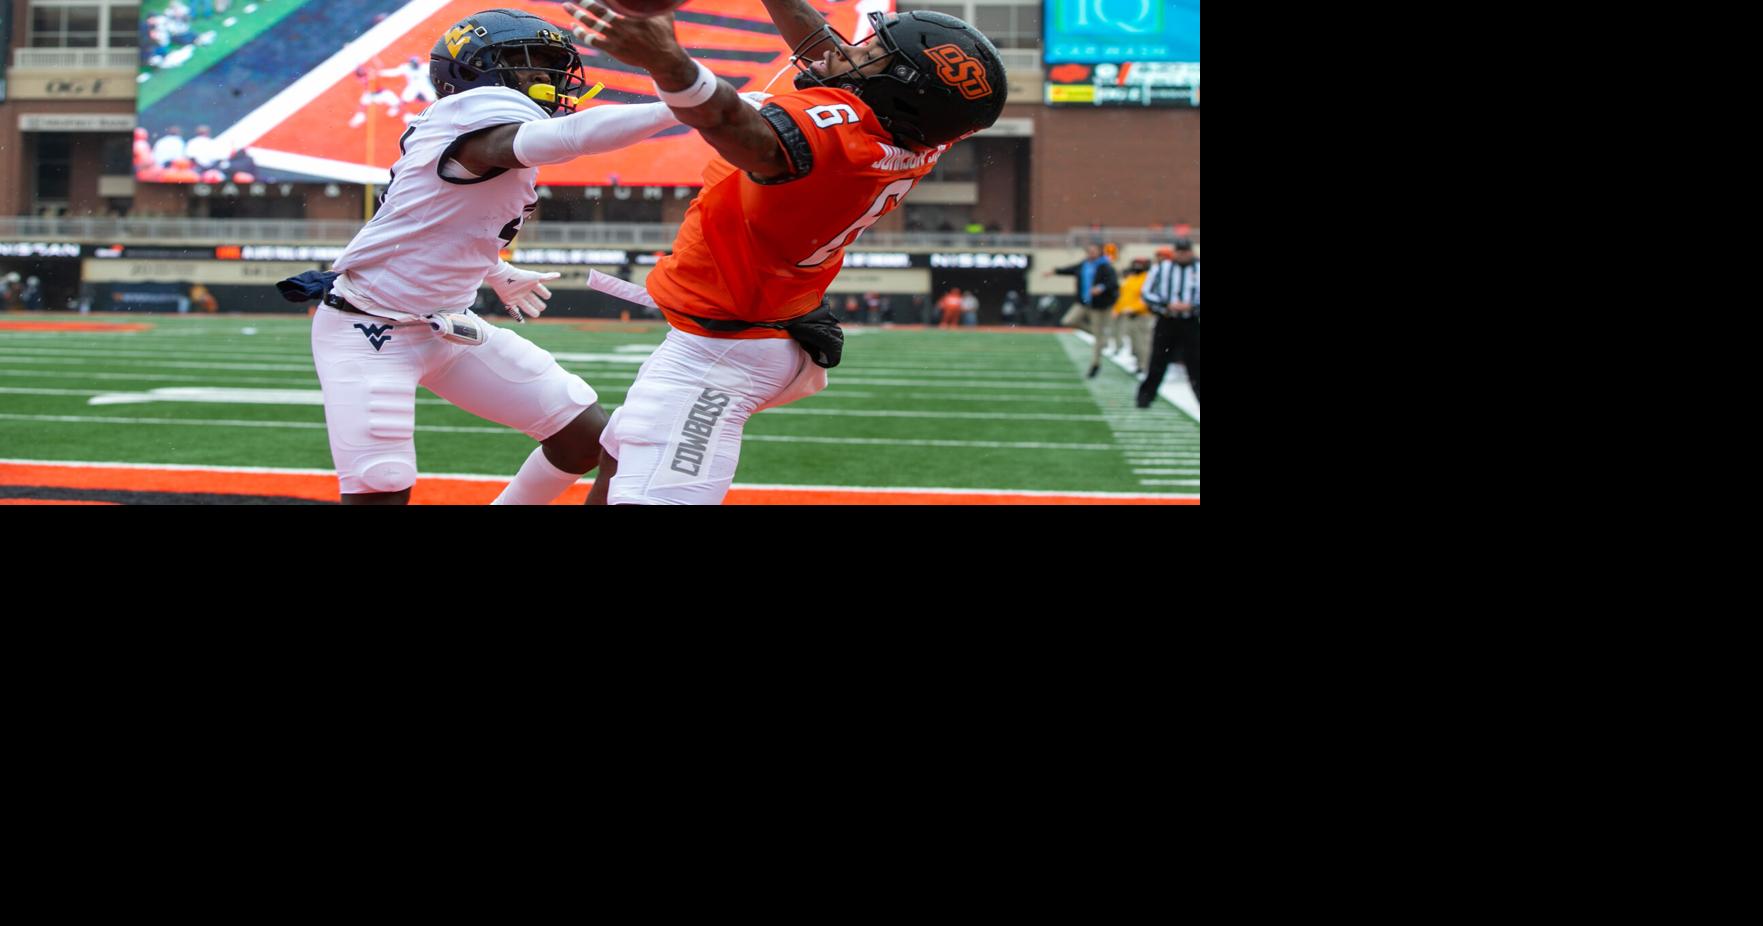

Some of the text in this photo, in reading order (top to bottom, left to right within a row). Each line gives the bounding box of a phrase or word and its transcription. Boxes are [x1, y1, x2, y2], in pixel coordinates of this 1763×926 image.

[923, 43, 993, 100] OSU
[804, 103, 861, 129] 6
[930, 253, 1028, 268] NISSAN
[671, 387, 730, 477] COWBOYS
